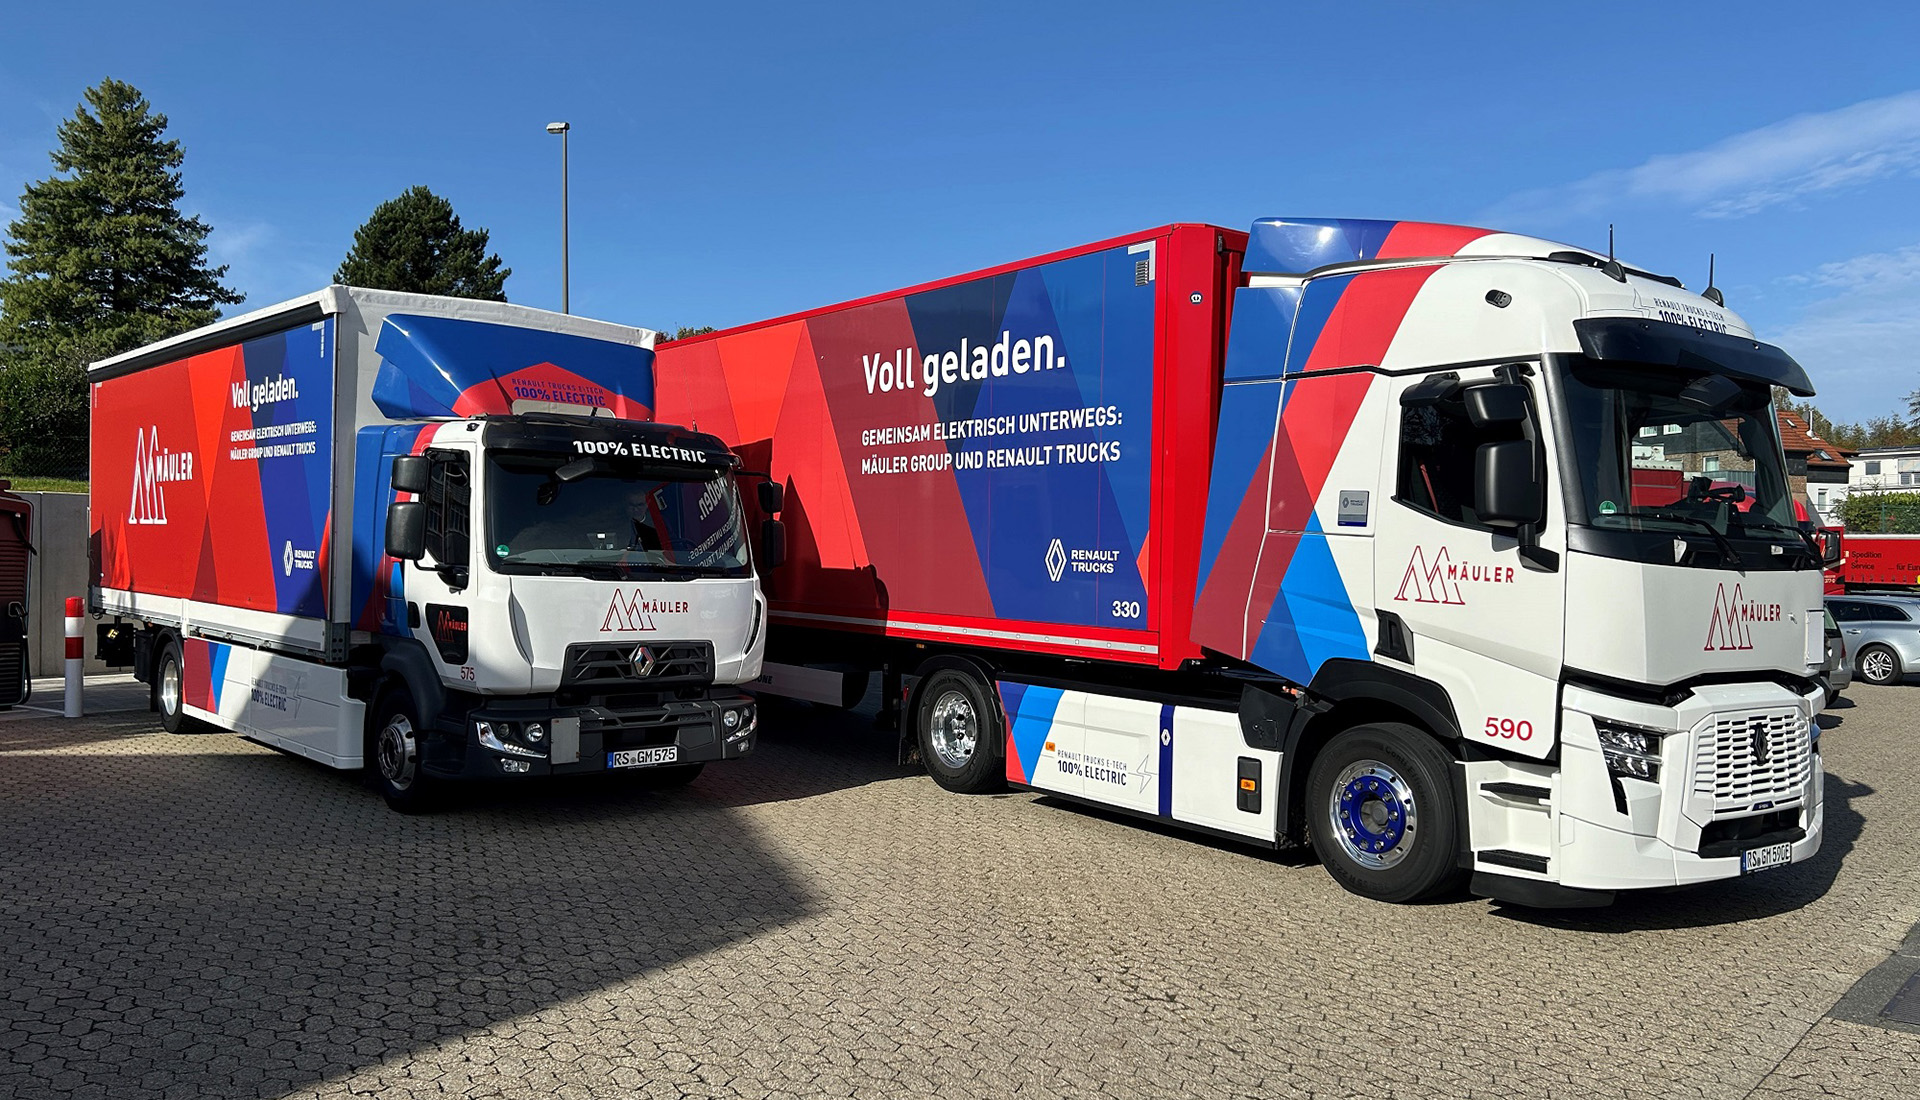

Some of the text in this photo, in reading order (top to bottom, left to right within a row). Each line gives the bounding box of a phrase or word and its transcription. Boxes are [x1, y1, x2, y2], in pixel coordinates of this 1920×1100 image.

[1653, 297, 1681, 311] RENAULT
[1681, 303, 1704, 316] TRUCKS
[862, 330, 1066, 398] Voll geladen.
[232, 373, 299, 412] Voll geladen.
[512, 378, 545, 388] RENAULT
[548, 382, 576, 391] TRUCKS
[514, 386, 606, 406] 100% ELECTRIC
[230, 421, 317, 442] GEMEINSAM ELEKTRISCH UNTERWEGS:
[861, 405, 1123, 446] GEMEINSAM ELEKTRISCH UNTERWEGS:
[230, 441, 316, 460] MÄULER GROUP UND RENAULT TRUCKS
[573, 440, 706, 463] 100% ELECTRIC
[861, 442, 1121, 475] MÄULER GROUP UND RENAULT TRUCKS
[156, 448, 193, 482] MÄULER
[294, 550, 316, 560] RENAULT
[1071, 549, 1119, 562] RENAULT
[1851, 551, 1882, 561] Spedition
[294, 560, 313, 570] TRUCKS
[1071, 562, 1115, 574] TRUCKS
[1448, 561, 1514, 584] MÄULER
[1851, 561, 1875, 570] Service
[642, 598, 689, 613] MÄULER
[1112, 601, 1140, 619] 330
[1741, 599, 1780, 622] MÄULER
[461, 667, 475, 681] 575
[265, 692, 287, 711] ELECTRIC
[1484, 717, 1533, 741] 590
[614, 753, 629, 766] RS
[637, 750, 652, 763] GM
[654, 748, 675, 761] 575
[1058, 749, 1127, 771] RENAULT TRUCKS E-TECH
[1058, 760, 1126, 786] 100% ELECTRIC
[1747, 851, 1757, 868] RS
